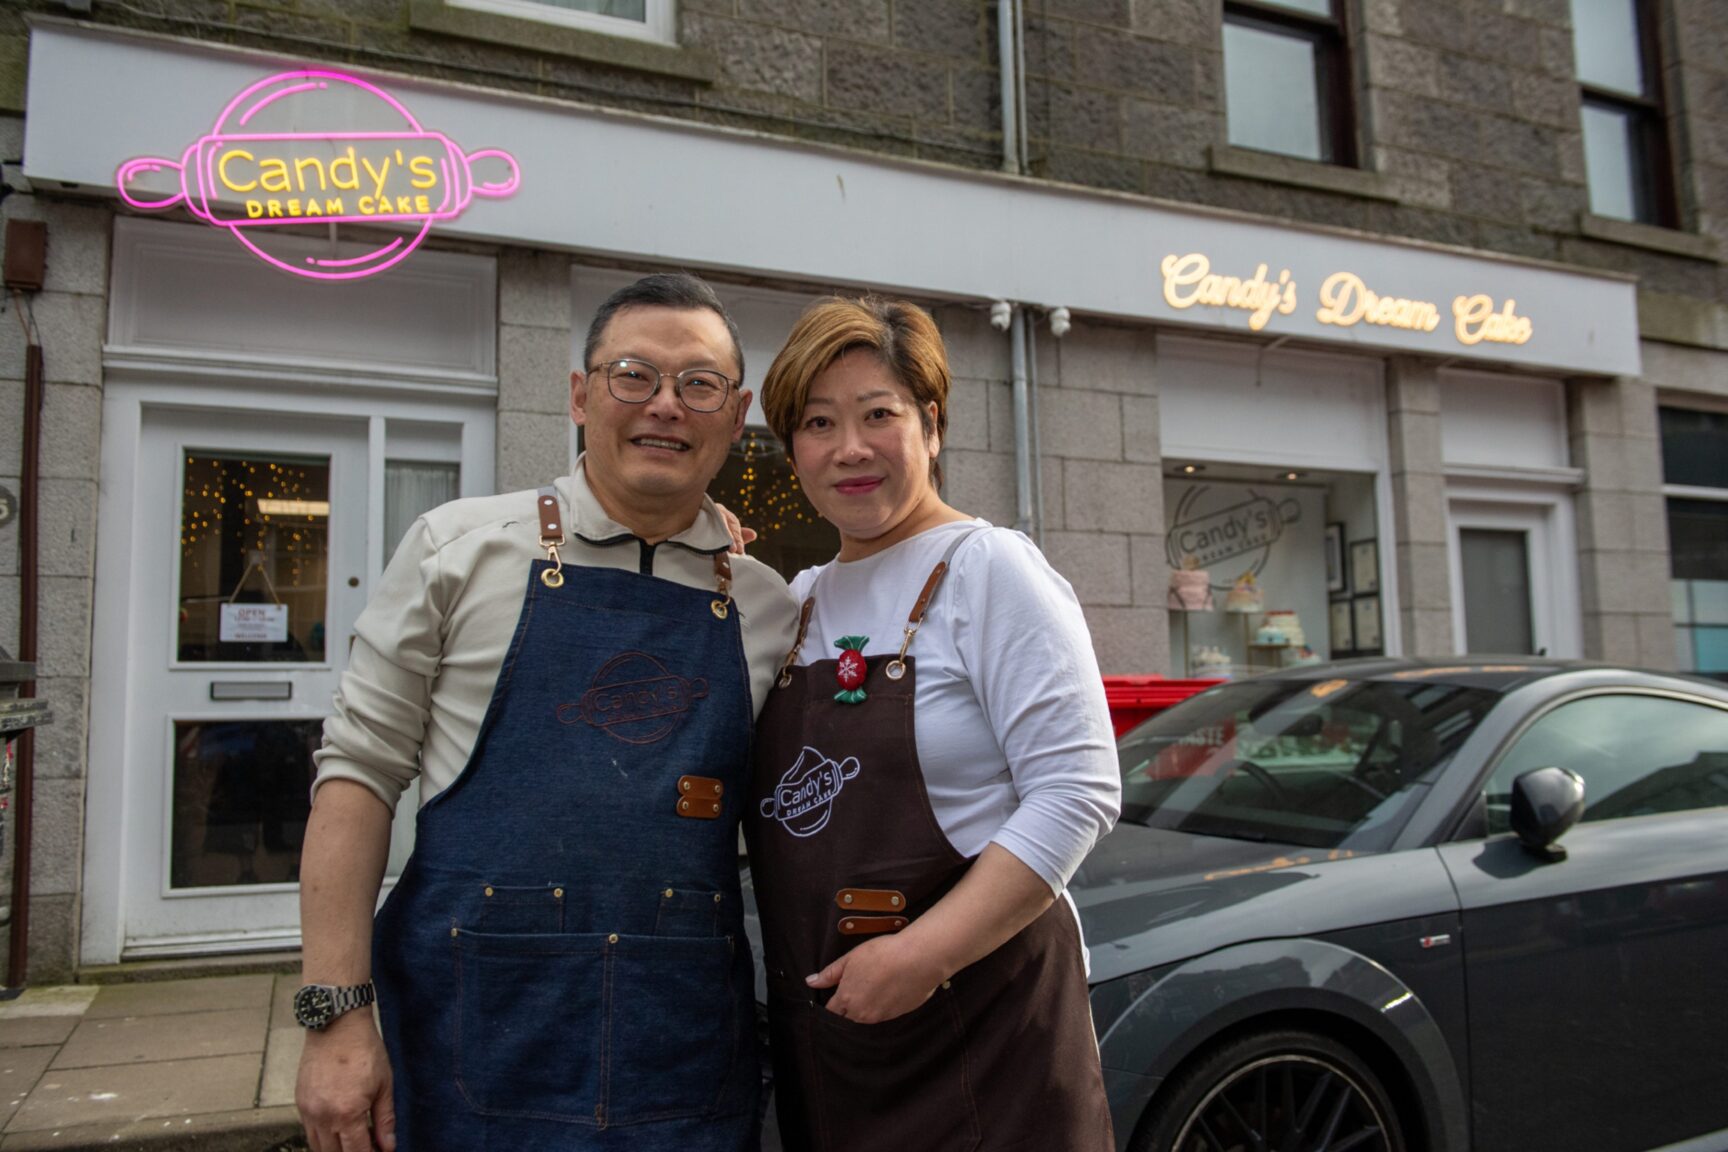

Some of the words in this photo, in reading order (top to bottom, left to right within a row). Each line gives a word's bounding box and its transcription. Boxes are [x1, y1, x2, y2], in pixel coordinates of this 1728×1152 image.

[218, 146, 437, 200] Candy's
[246, 198, 345, 219] DREAM
[358, 194, 432, 215] CAKE
[1160, 252, 1297, 331] Candy's
[1316, 271, 1440, 332] Dream
[1451, 294, 1533, 345] Cake
[1179, 508, 1267, 553] Candy's
[780, 771, 833, 806] Candy's
[786, 800, 811, 816] DREAM
[813, 789, 832, 804] CAKE
